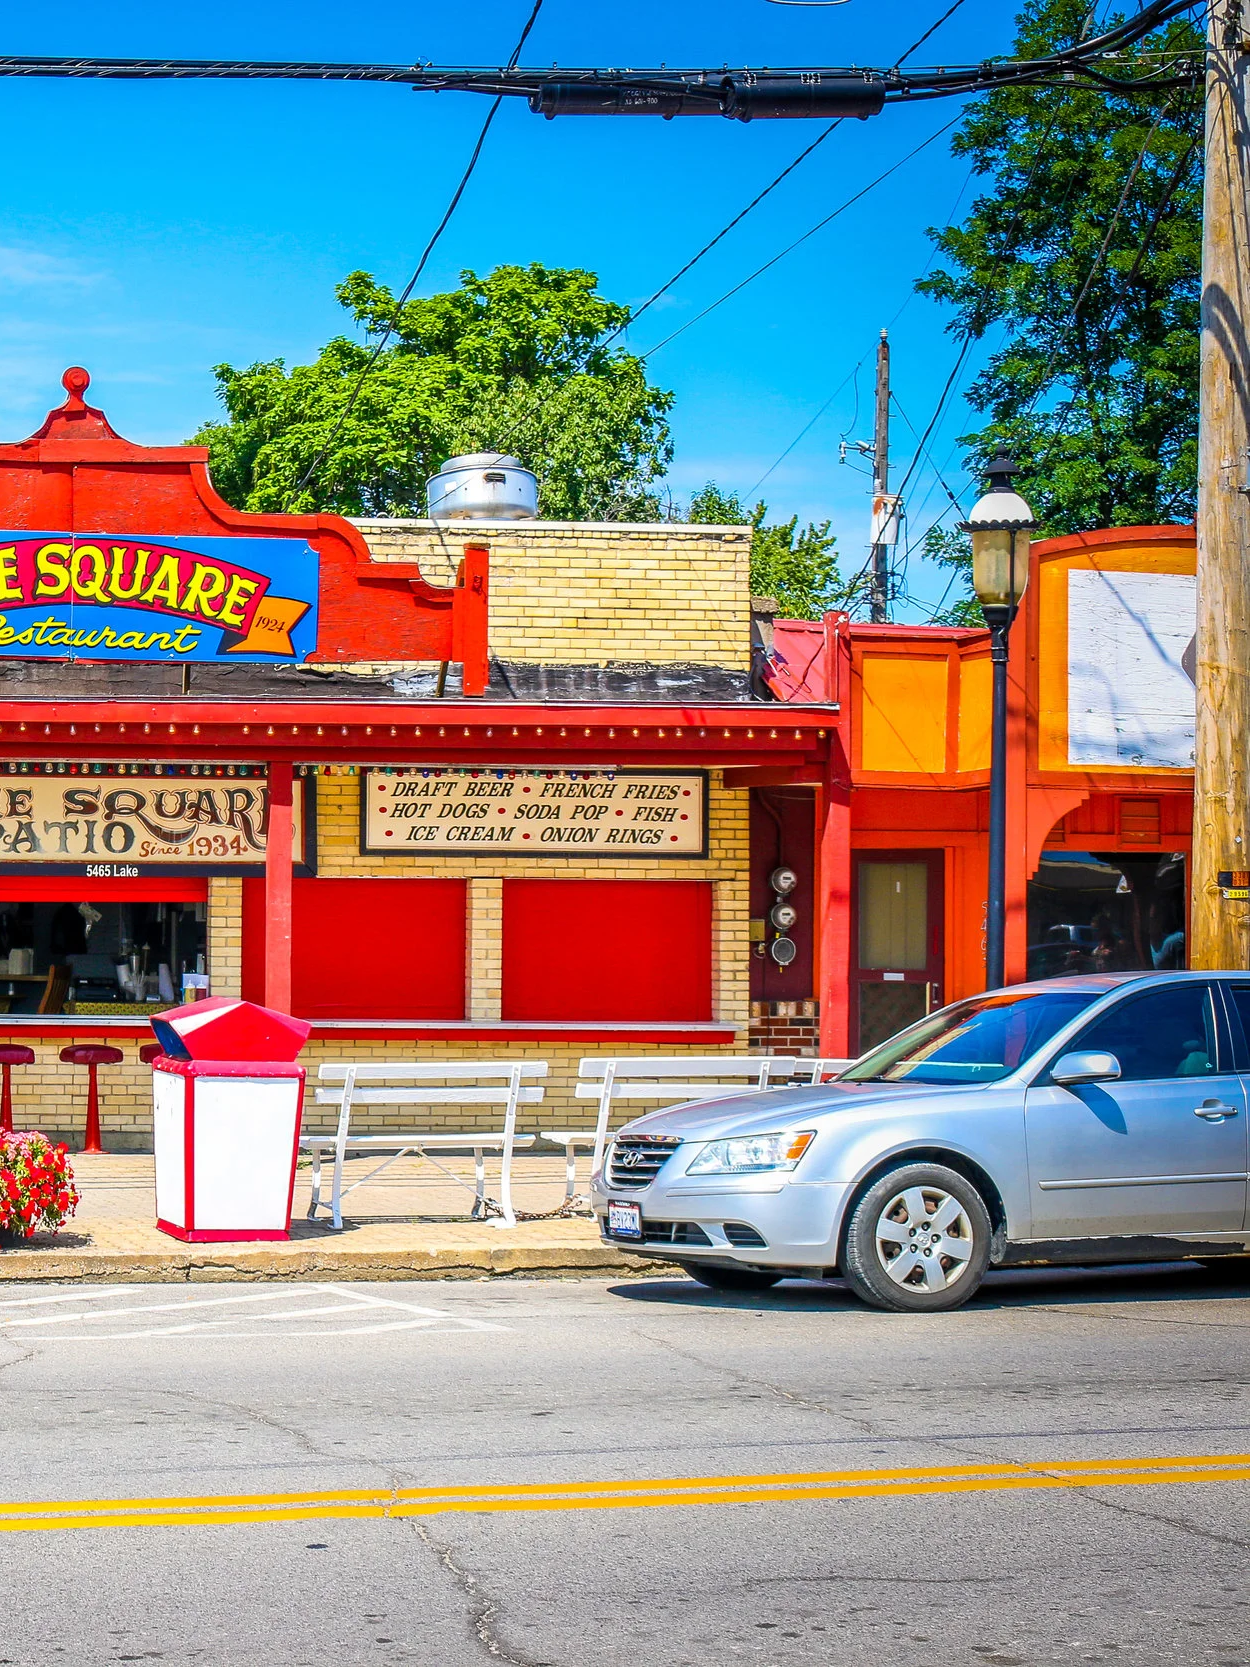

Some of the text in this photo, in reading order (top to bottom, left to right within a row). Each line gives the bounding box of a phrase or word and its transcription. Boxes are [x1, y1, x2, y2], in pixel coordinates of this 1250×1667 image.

[34, 543, 260, 628] SQUARE
[254, 615, 286, 633] 1924
[391, 781, 681, 800] DRAFT BEER FRENCH FRIES
[389, 802, 679, 822] HOT DOGS SODA POP FISH
[405, 825, 664, 844] ICE CREAM ONION RINGS
[139, 841, 182, 858] Since
[187, 834, 249, 857] 1934
[86, 864, 139, 877] 5465 Lake
